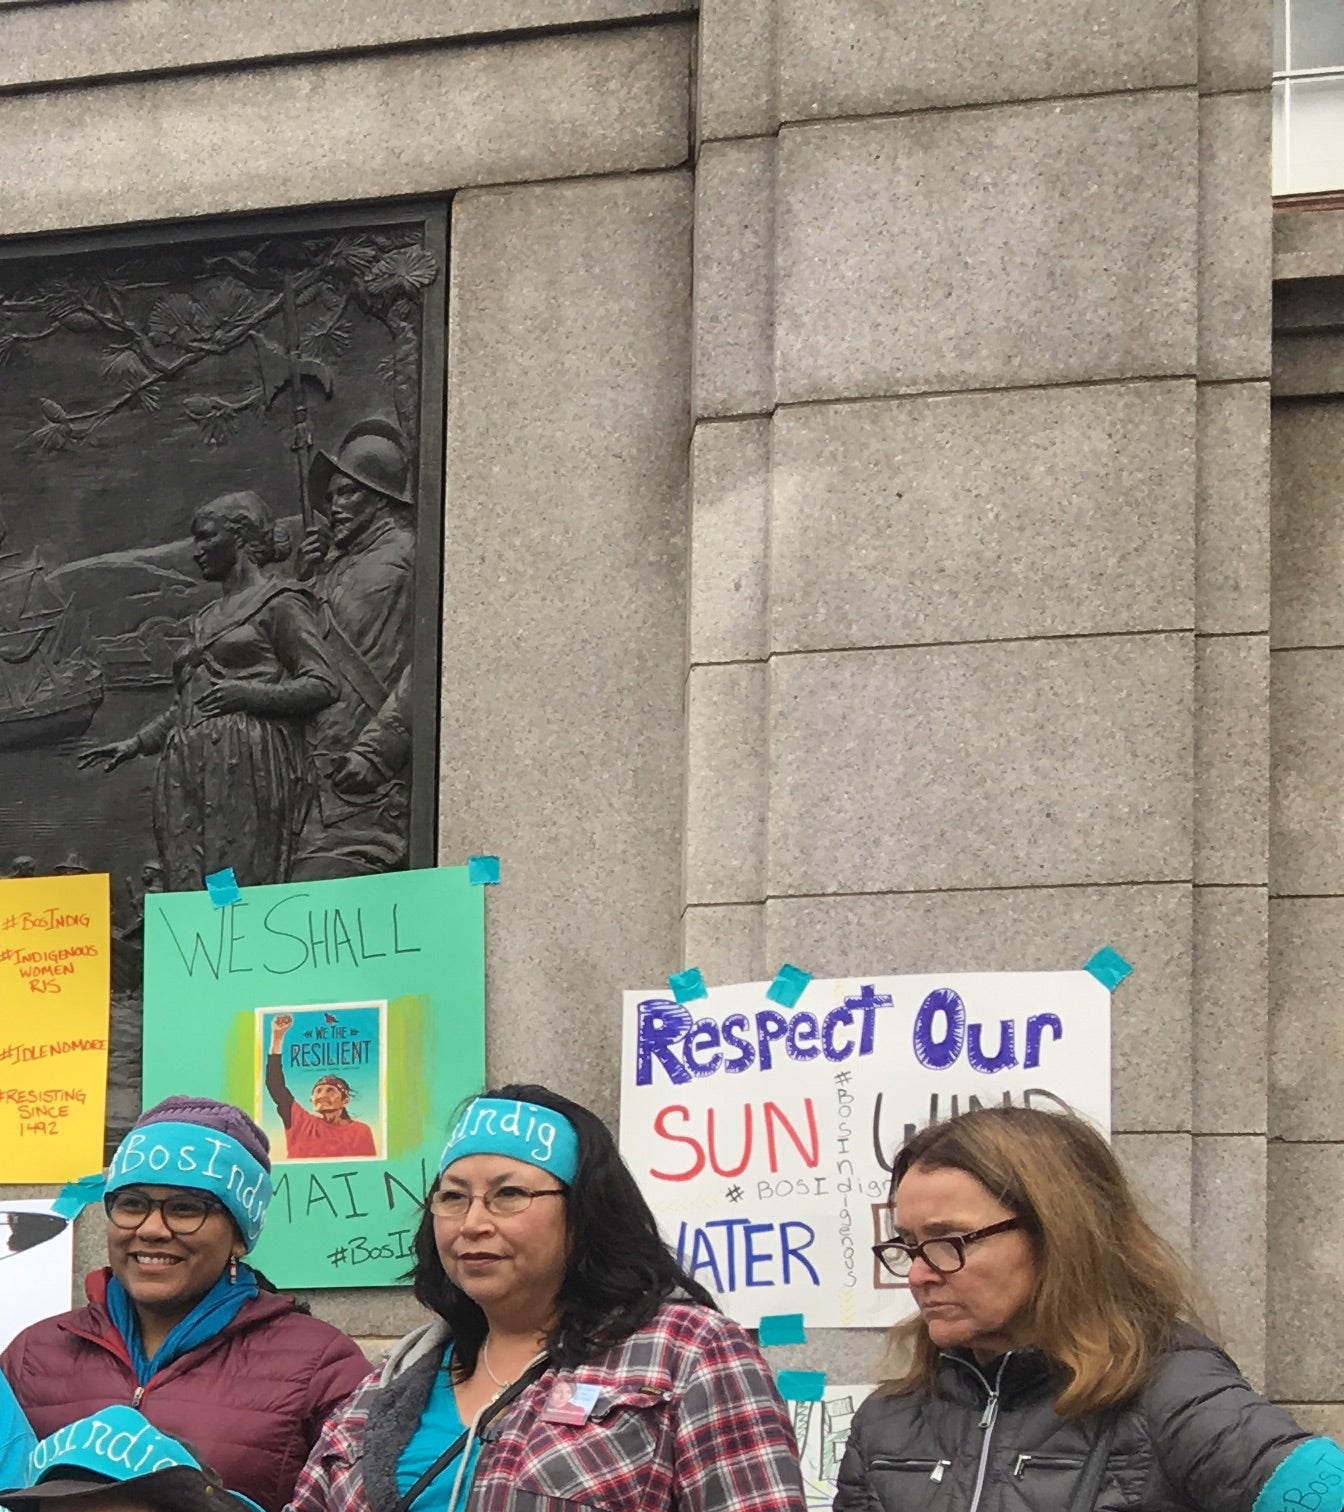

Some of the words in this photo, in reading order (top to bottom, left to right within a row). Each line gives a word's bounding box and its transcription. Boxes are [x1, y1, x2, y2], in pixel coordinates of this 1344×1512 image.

[262, 893, 422, 974] SHALL
[19, 962, 75, 978] WOMEN
[636, 984, 894, 1086] Respect
[913, 987, 1063, 1074] Our
[290, 1040, 372, 1067] RESILIENT
[17, 1105, 70, 1119] SINCE
[19, 1121, 59, 1136] 1492
[649, 1097, 820, 1182] SUN
